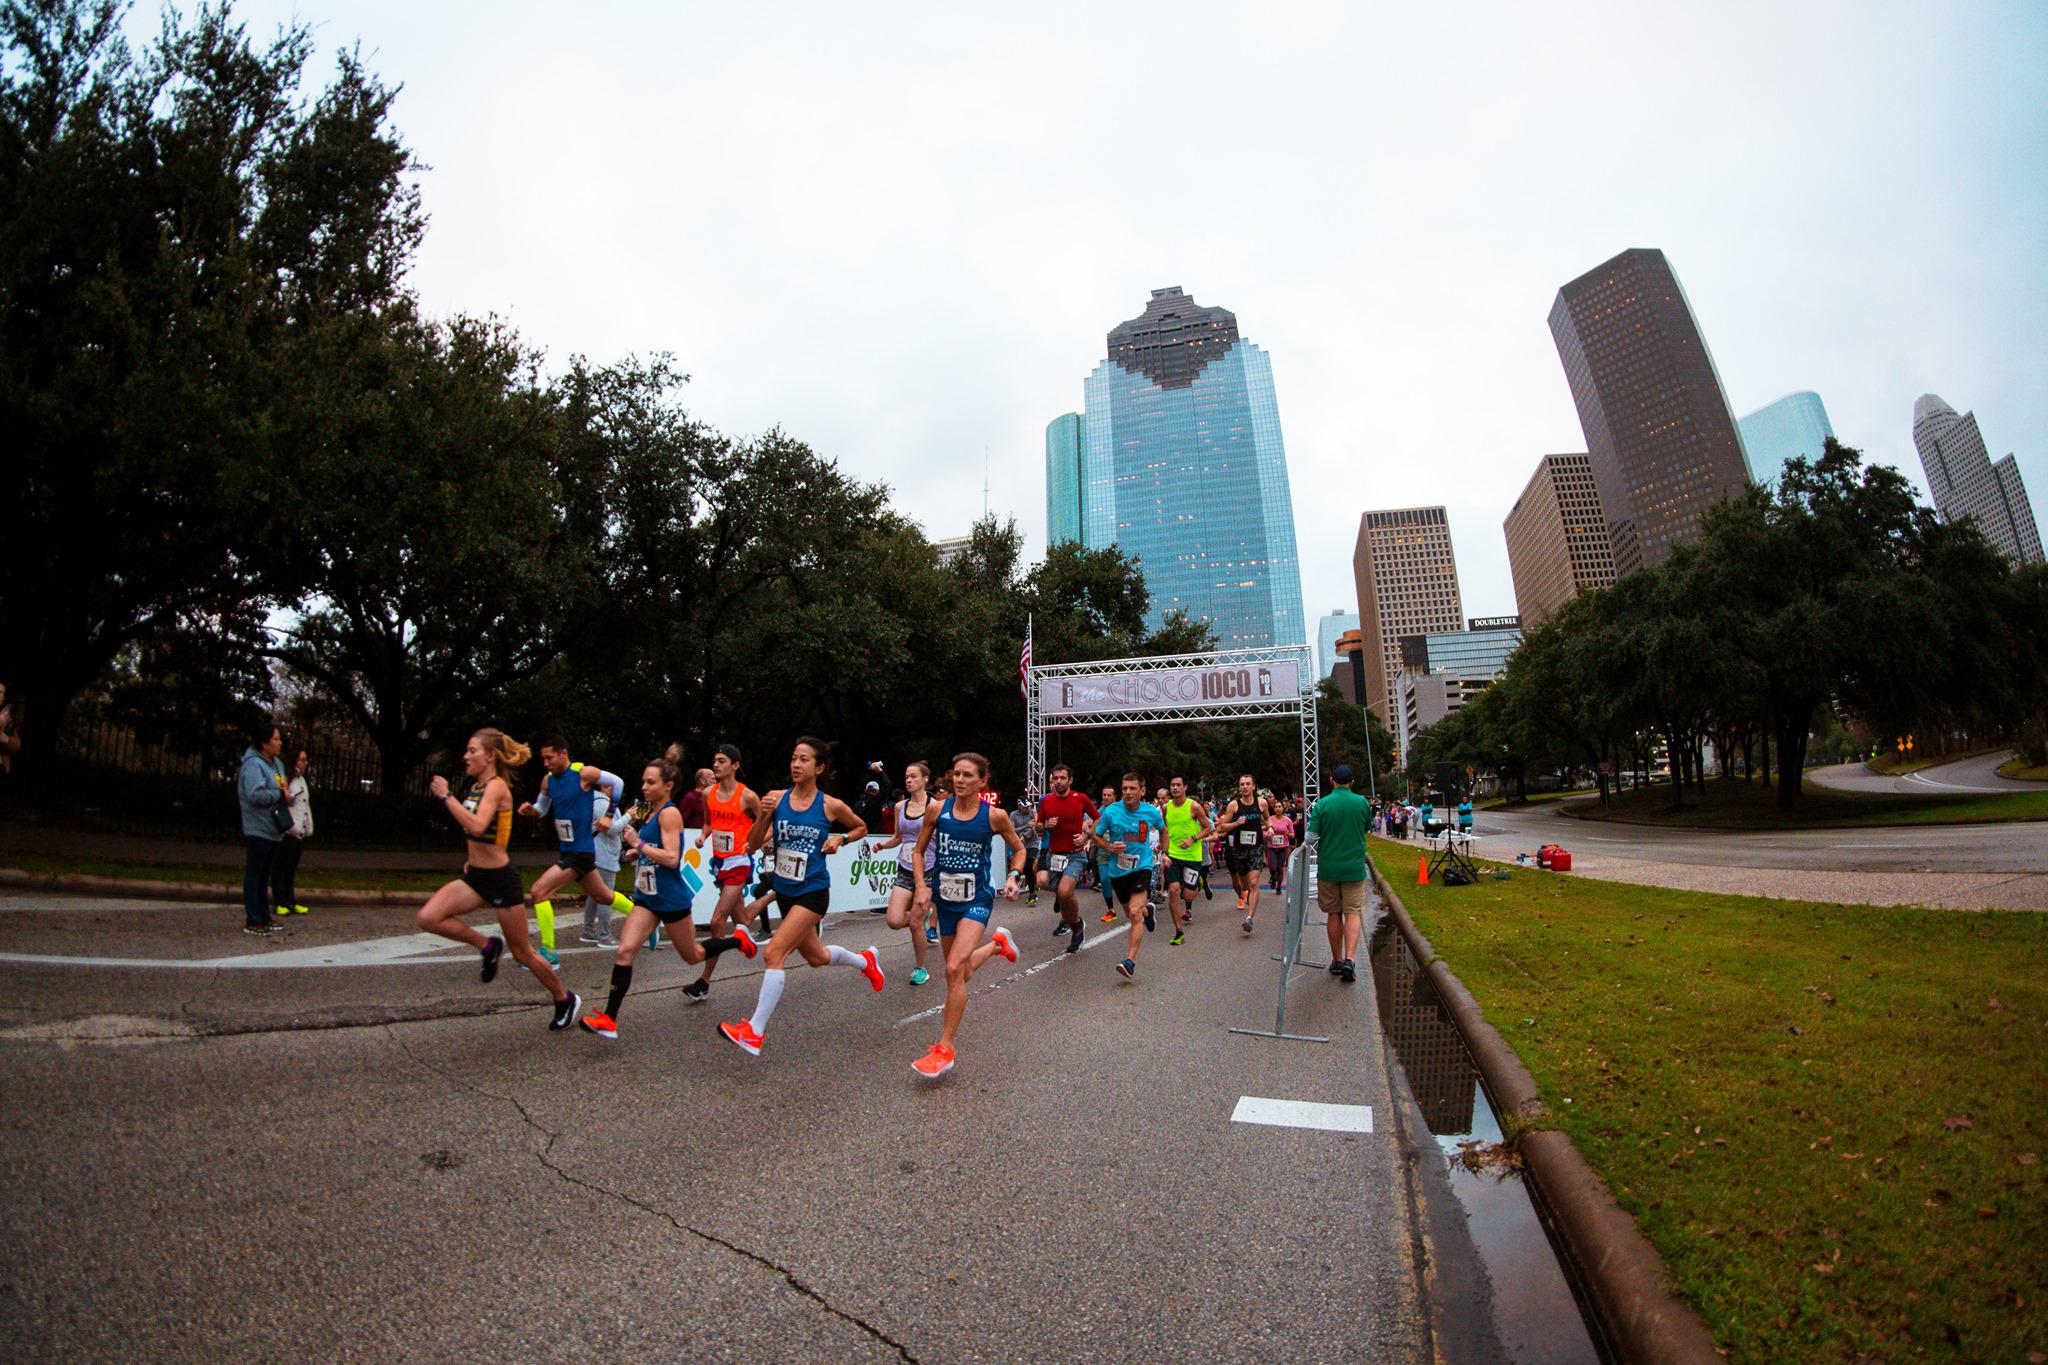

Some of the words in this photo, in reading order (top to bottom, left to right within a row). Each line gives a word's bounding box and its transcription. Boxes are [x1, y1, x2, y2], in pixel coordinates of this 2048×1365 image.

[1474, 617, 1517, 627] DOUBLETREE
[1107, 674, 1199, 704] CHOCO
[777, 819, 821, 840] HOUSTON
[939, 832, 983, 854] HOUSTON
[850, 858, 898, 886] green
